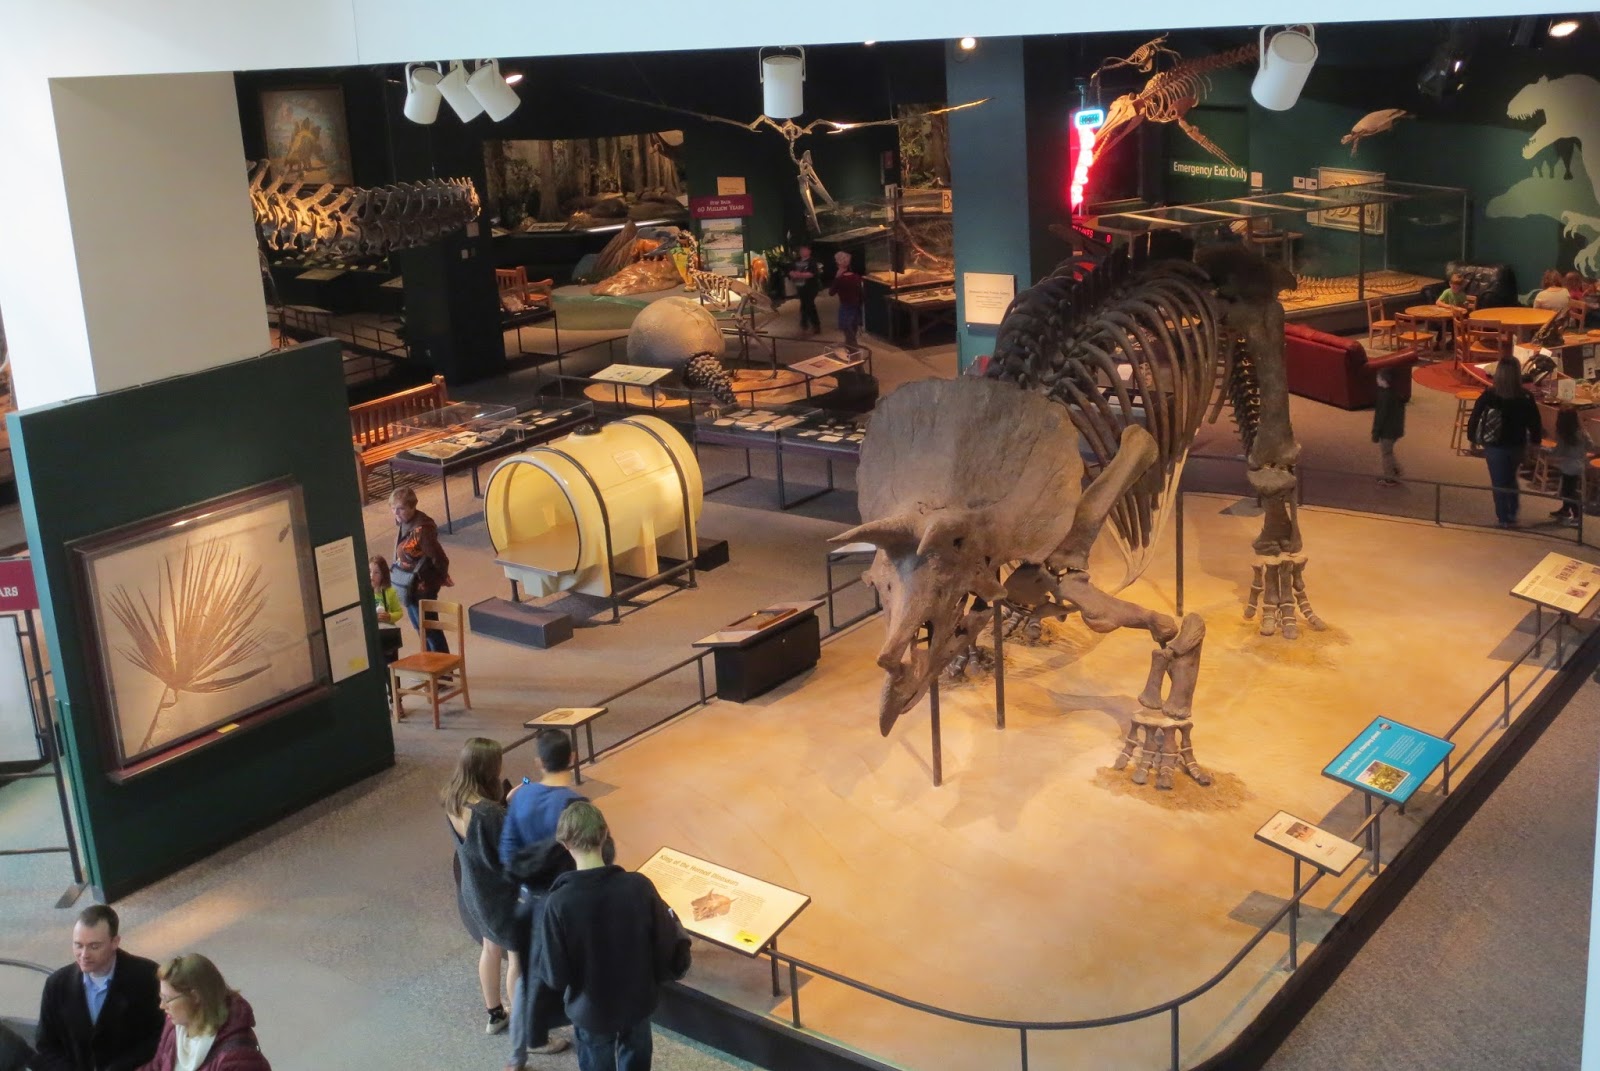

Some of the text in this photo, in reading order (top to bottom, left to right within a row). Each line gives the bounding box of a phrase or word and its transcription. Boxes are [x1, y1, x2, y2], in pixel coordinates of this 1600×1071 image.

[1173, 161, 1248, 182] Emergency Exit Only
